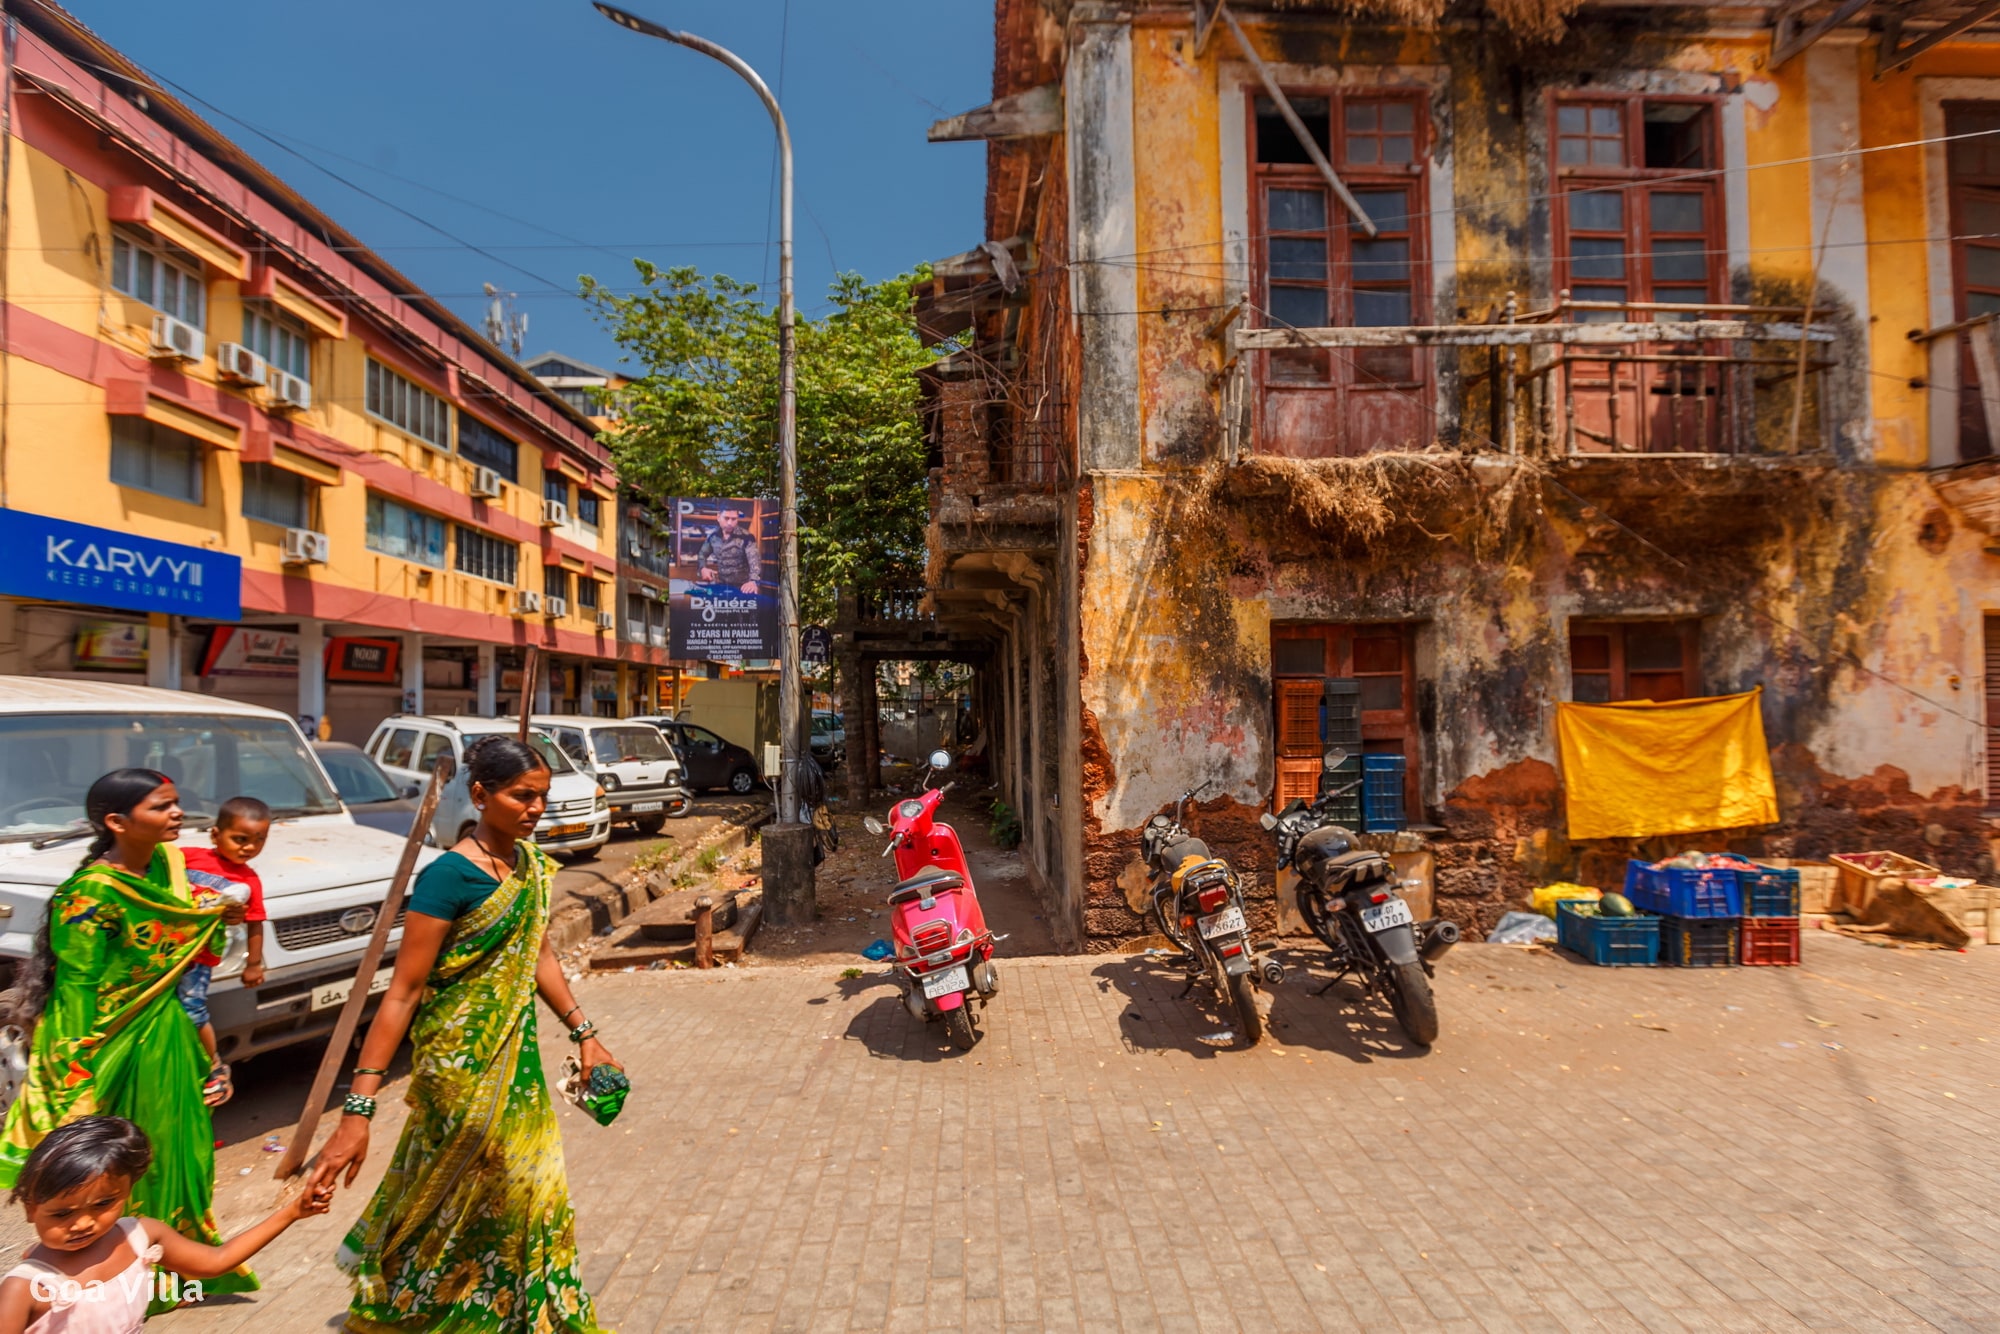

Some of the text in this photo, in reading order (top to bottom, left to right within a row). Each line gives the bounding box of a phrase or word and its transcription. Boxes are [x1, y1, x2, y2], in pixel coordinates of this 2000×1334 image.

[47, 569, 204, 603] KEEP GROWING
[689, 629, 759, 638] 3 YEARS IN PANJIM
[811, 629, 821, 640] P
